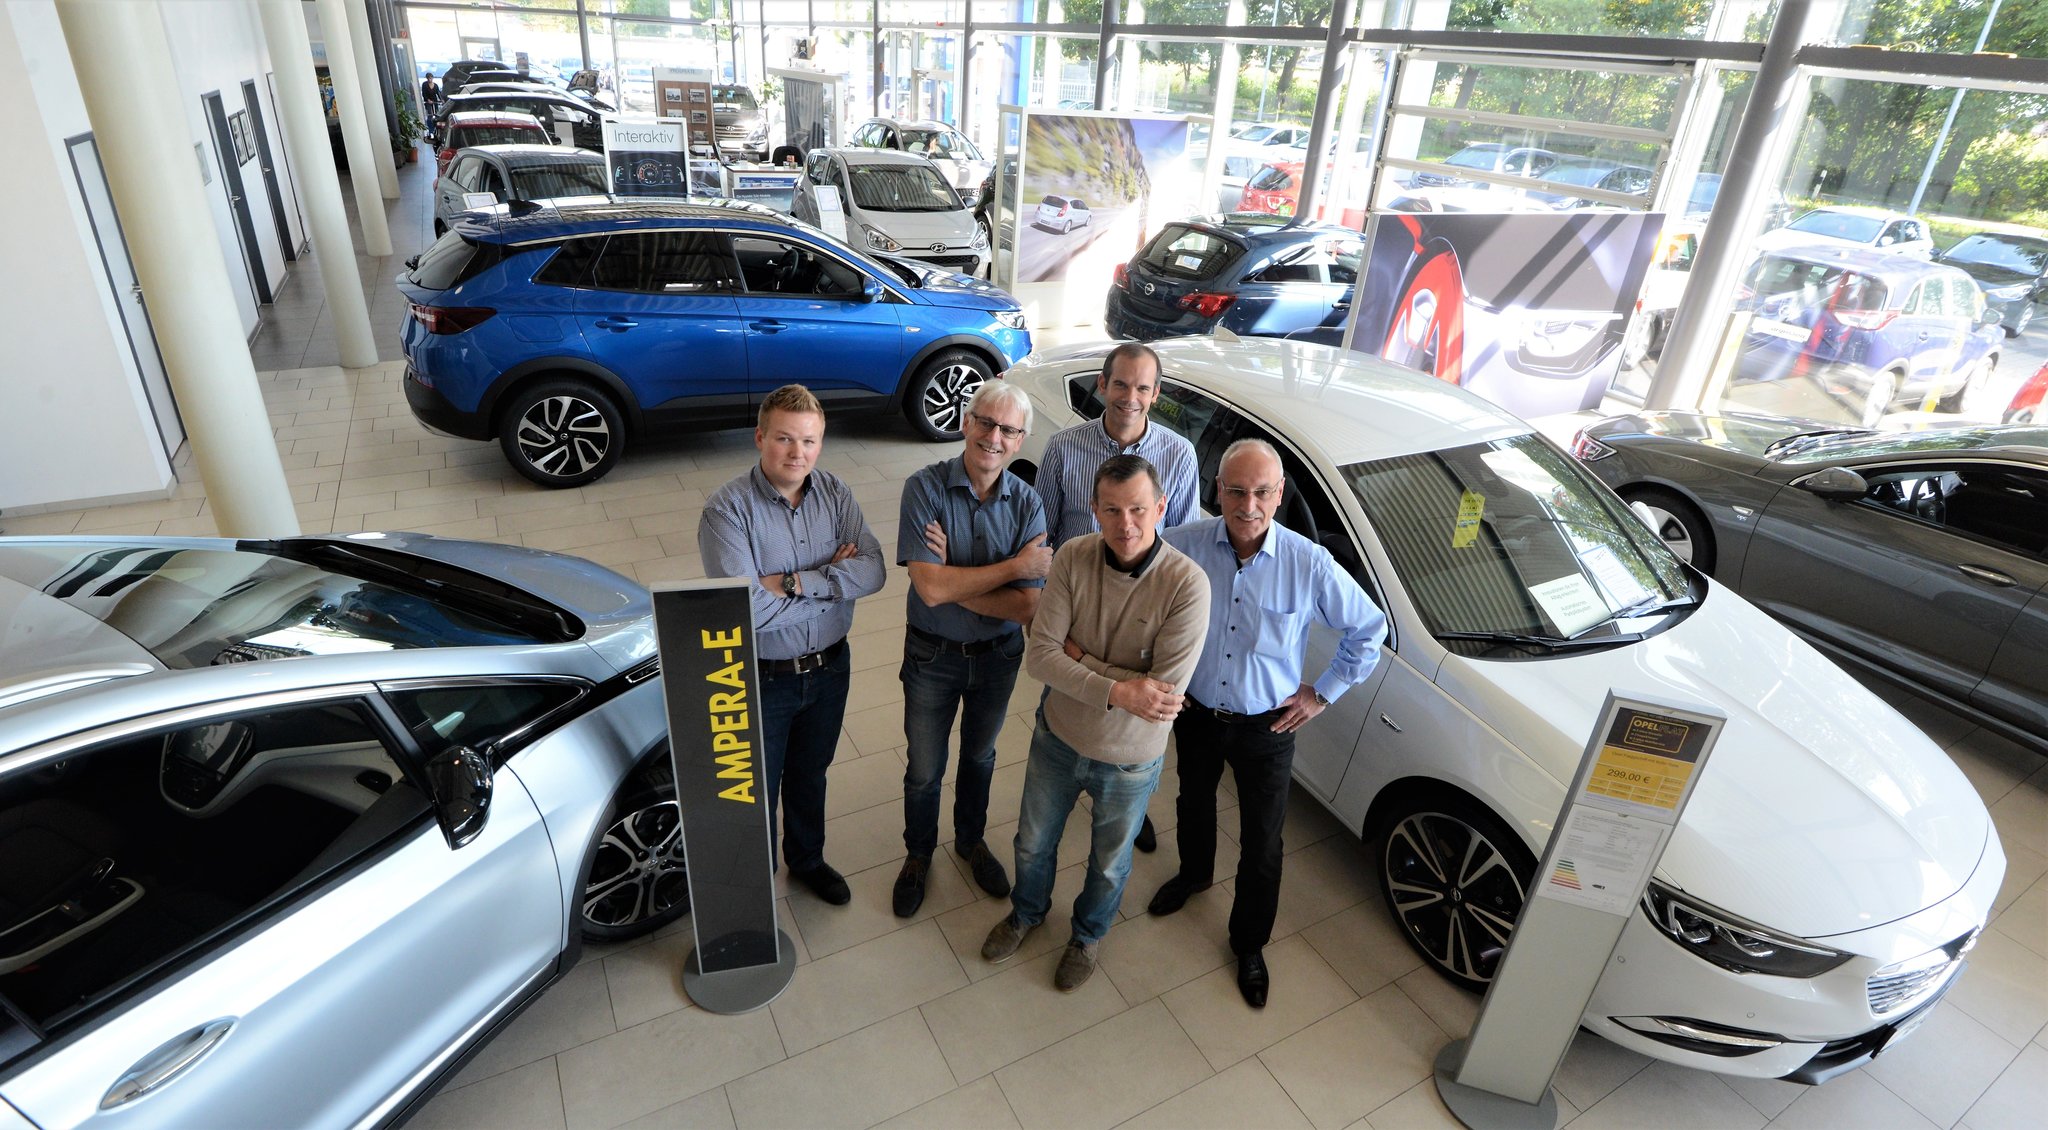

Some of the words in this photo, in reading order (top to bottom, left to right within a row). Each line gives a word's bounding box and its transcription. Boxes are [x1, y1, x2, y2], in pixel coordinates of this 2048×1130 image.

[614, 129, 674, 143] Interaktiv
[701, 625, 756, 804] AMPERA-E
[1633, 718, 1660, 732] OPEL
[1607, 767, 1642, 783] 299.00
[1643, 775, 1652, 785] €
